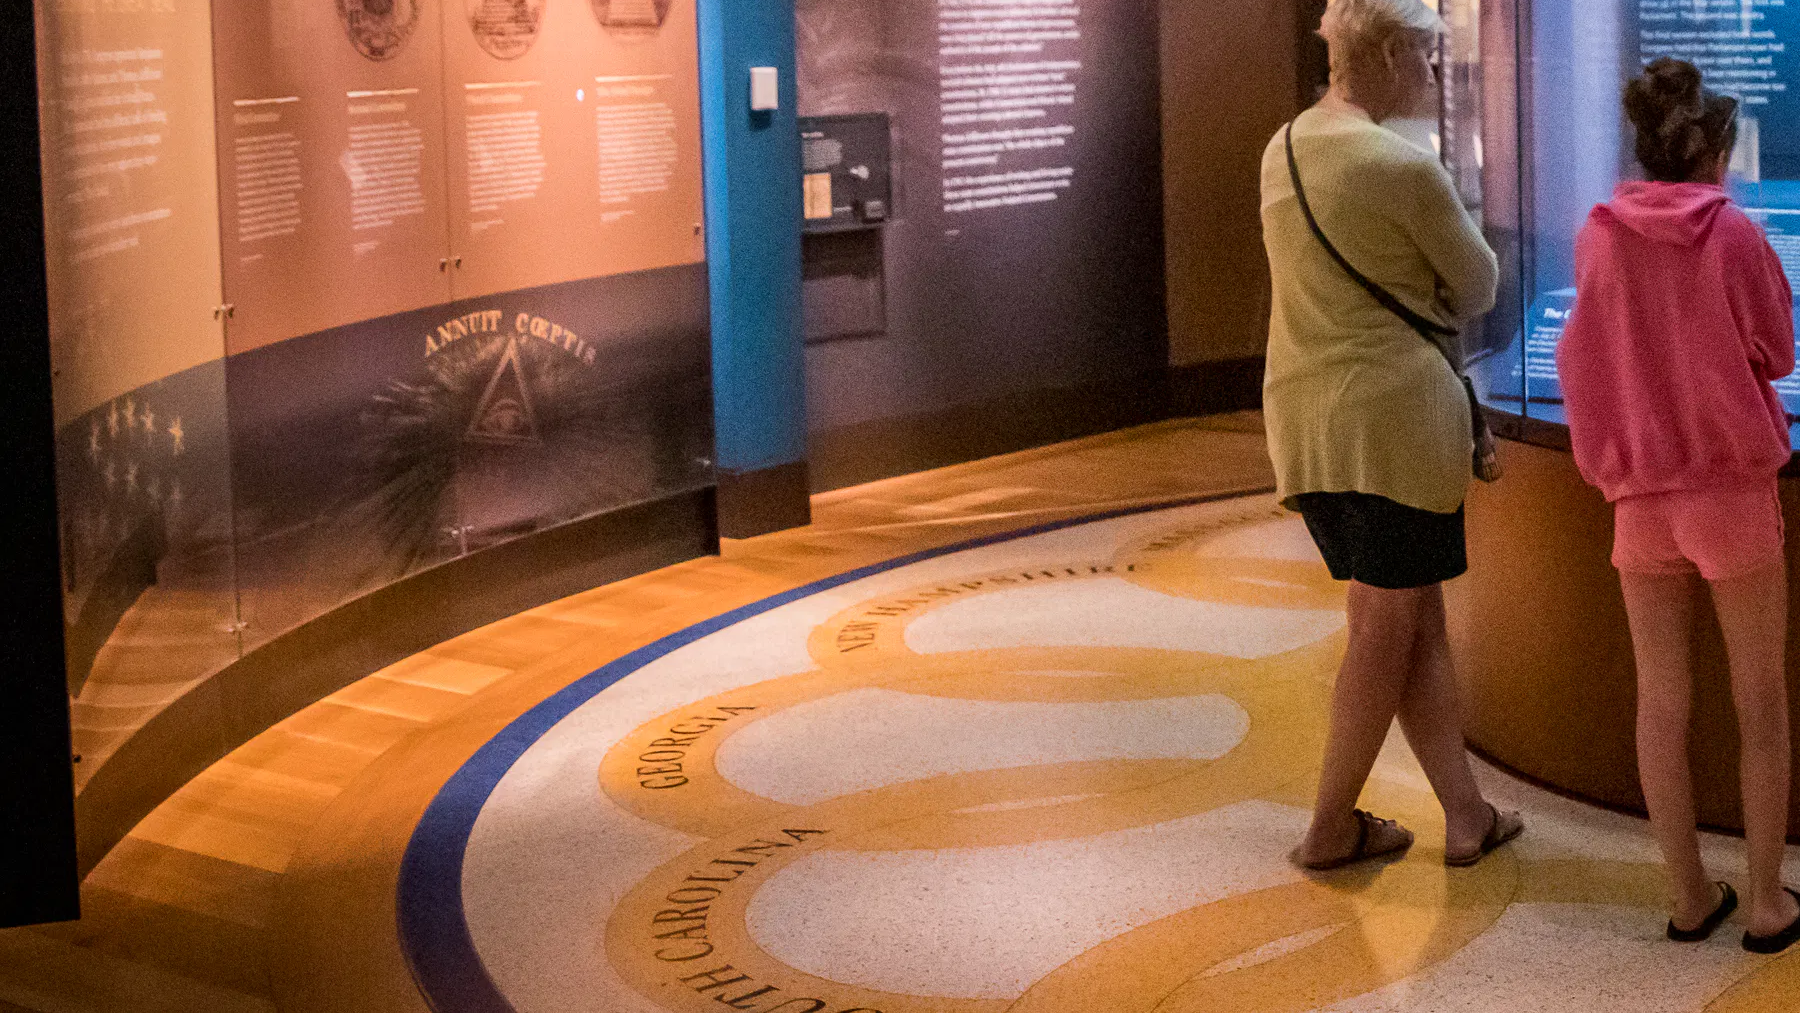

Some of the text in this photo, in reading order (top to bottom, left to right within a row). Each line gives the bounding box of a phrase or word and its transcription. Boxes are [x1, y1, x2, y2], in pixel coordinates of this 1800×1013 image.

[424, 309, 503, 358] ANNUIT
[636, 701, 757, 791] GEORGIA
[652, 828, 831, 963] CAROLINA
